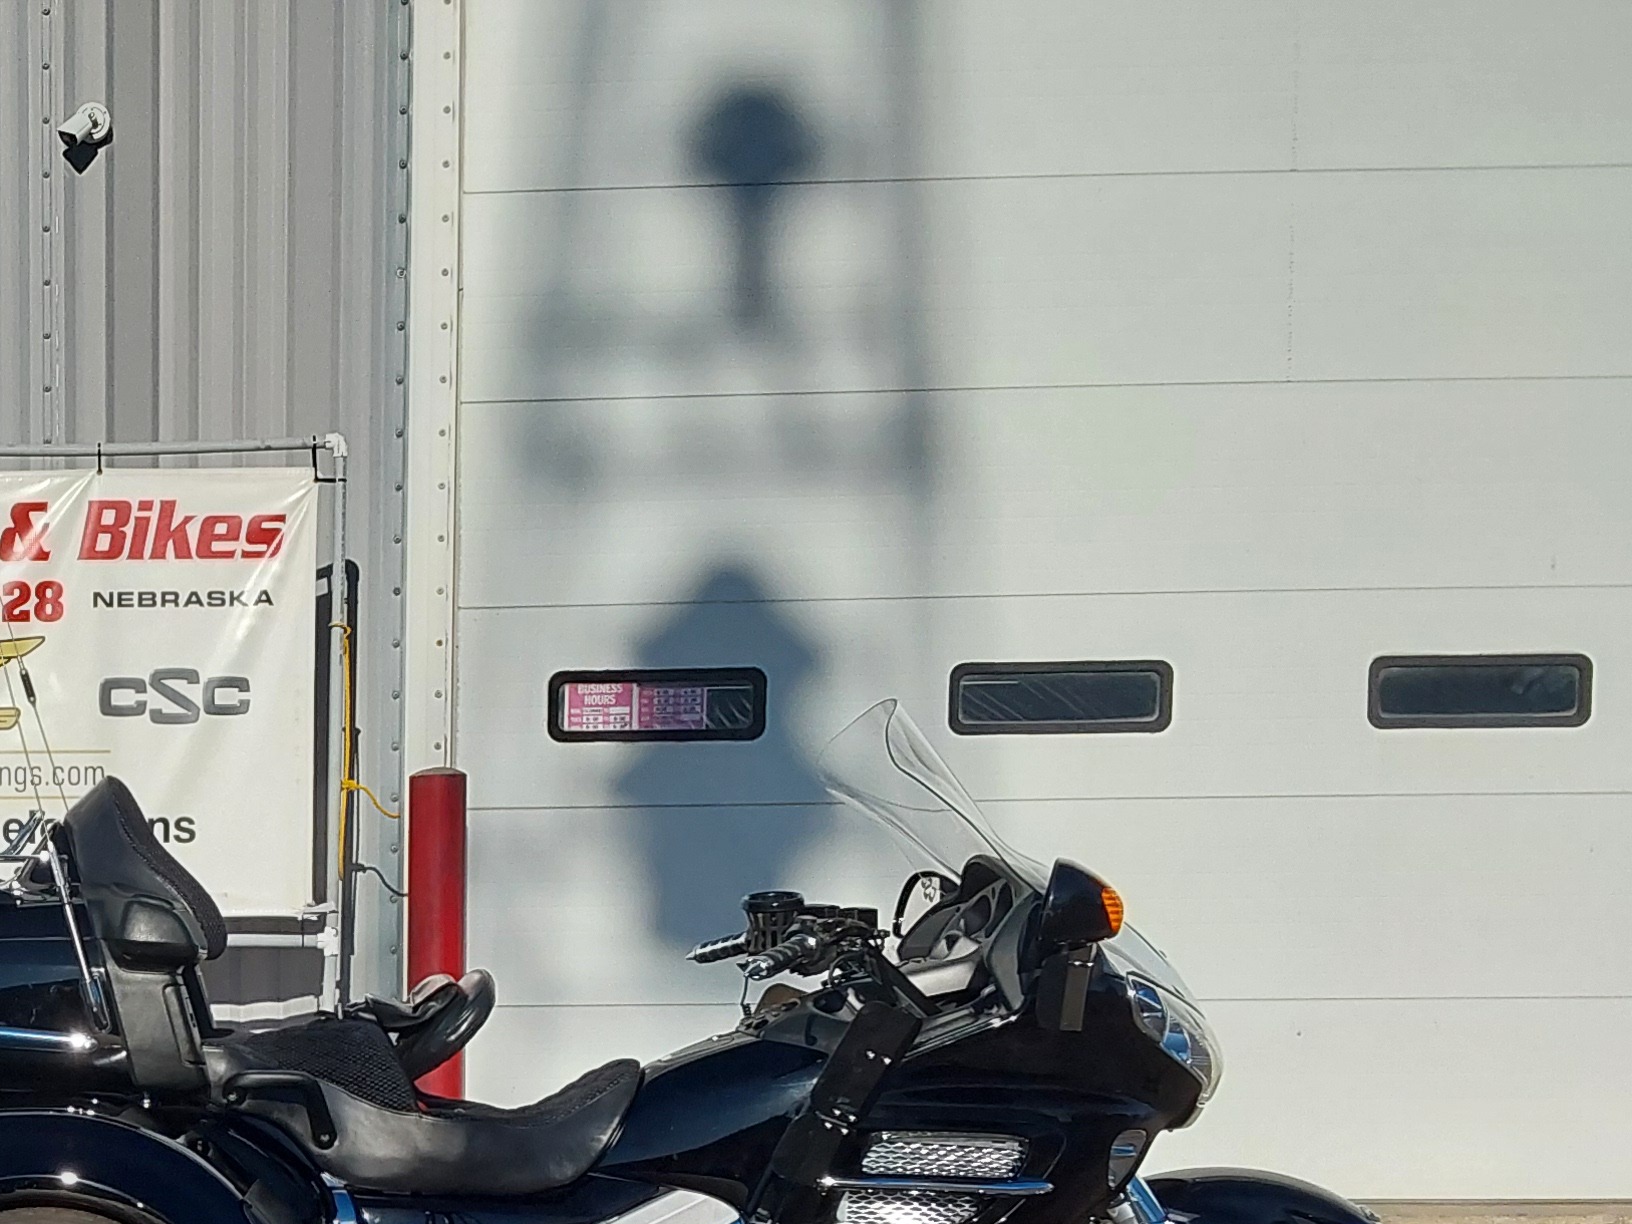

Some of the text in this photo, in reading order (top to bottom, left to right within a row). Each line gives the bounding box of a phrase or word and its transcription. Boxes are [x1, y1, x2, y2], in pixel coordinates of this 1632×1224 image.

[77, 499, 288, 561] Bikes
[92, 590, 274, 608] NEBRASKA
[583, 694, 617, 705] HOURS
